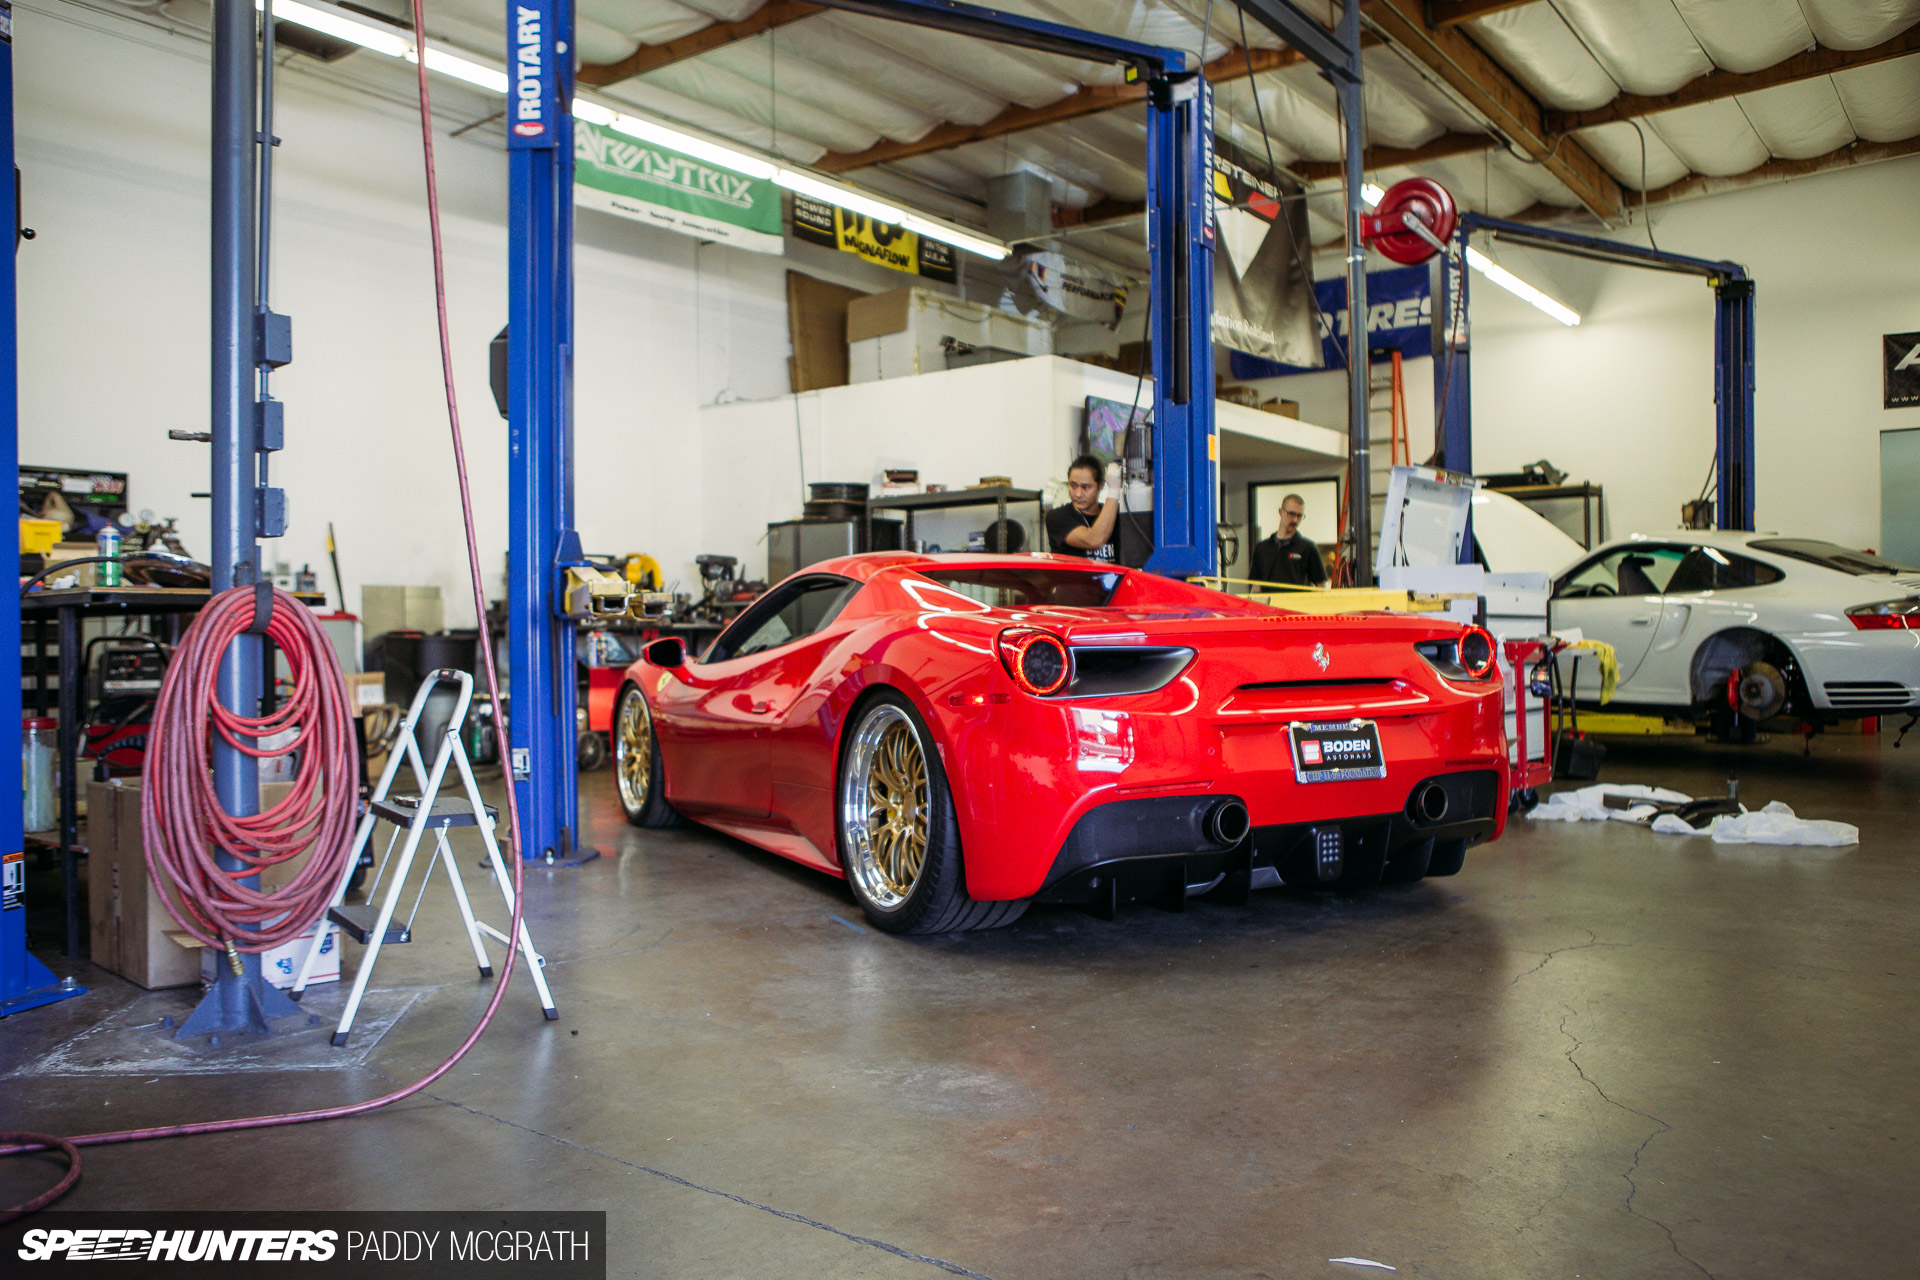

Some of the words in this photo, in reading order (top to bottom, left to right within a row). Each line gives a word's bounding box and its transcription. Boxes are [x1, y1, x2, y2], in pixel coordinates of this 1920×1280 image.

[517, 5, 542, 120] ROTARY
[1204, 80, 1213, 131] LIFT
[1204, 133, 1213, 228] ROTARY
[794, 198, 832, 217] POWER
[1337, 297, 1432, 337] TRES
[1322, 738, 1371, 753] BODEN
[1326, 752, 1372, 761] AUTOHAUS
